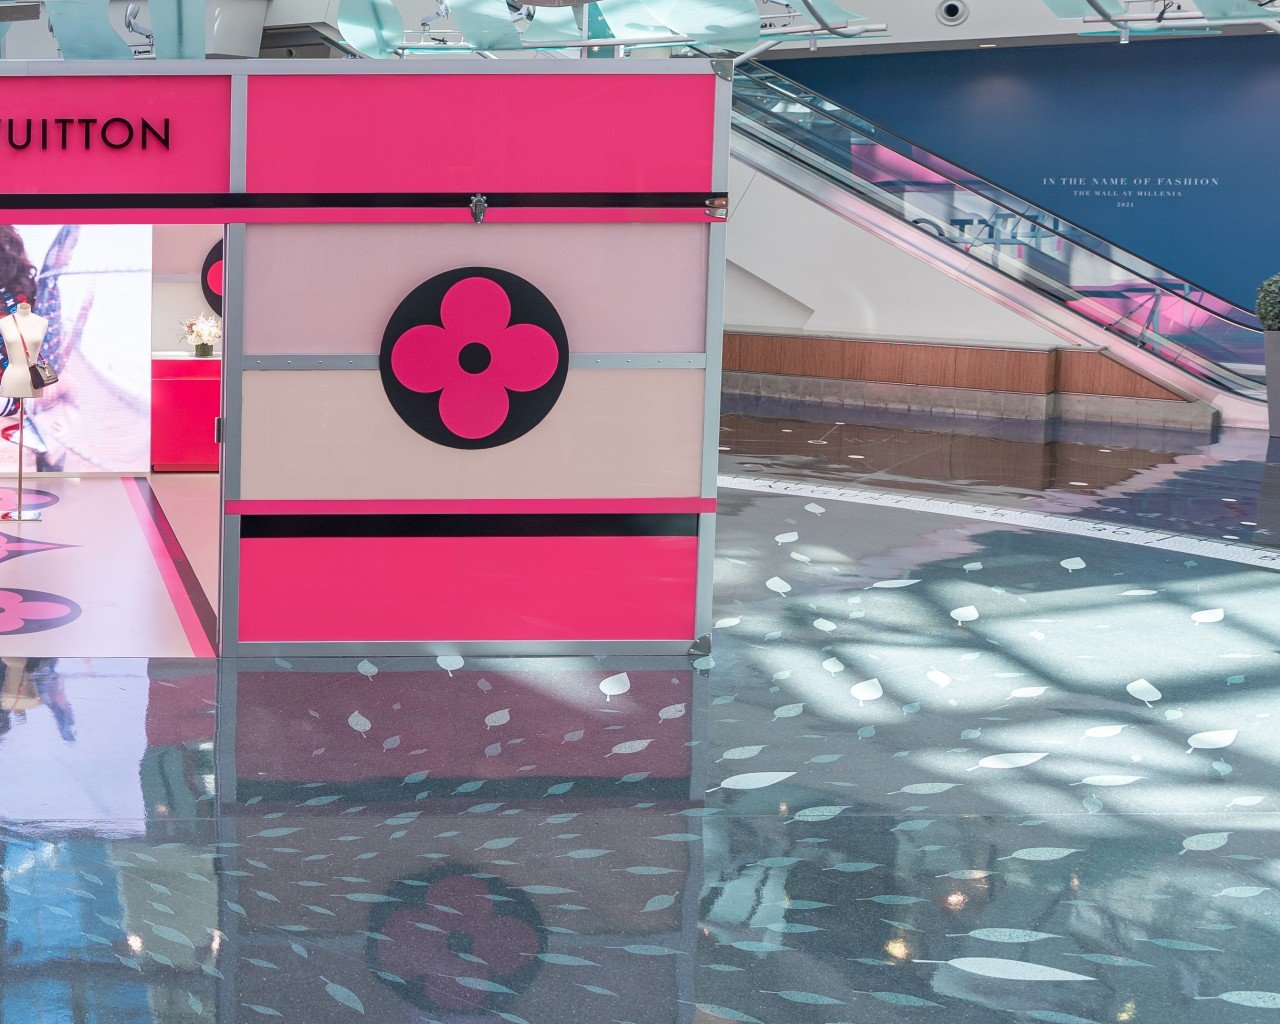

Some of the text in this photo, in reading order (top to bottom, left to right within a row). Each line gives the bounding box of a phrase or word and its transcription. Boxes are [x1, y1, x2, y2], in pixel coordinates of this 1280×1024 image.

[1043, 178, 1219, 186] IN THE NAME OF FASHION
